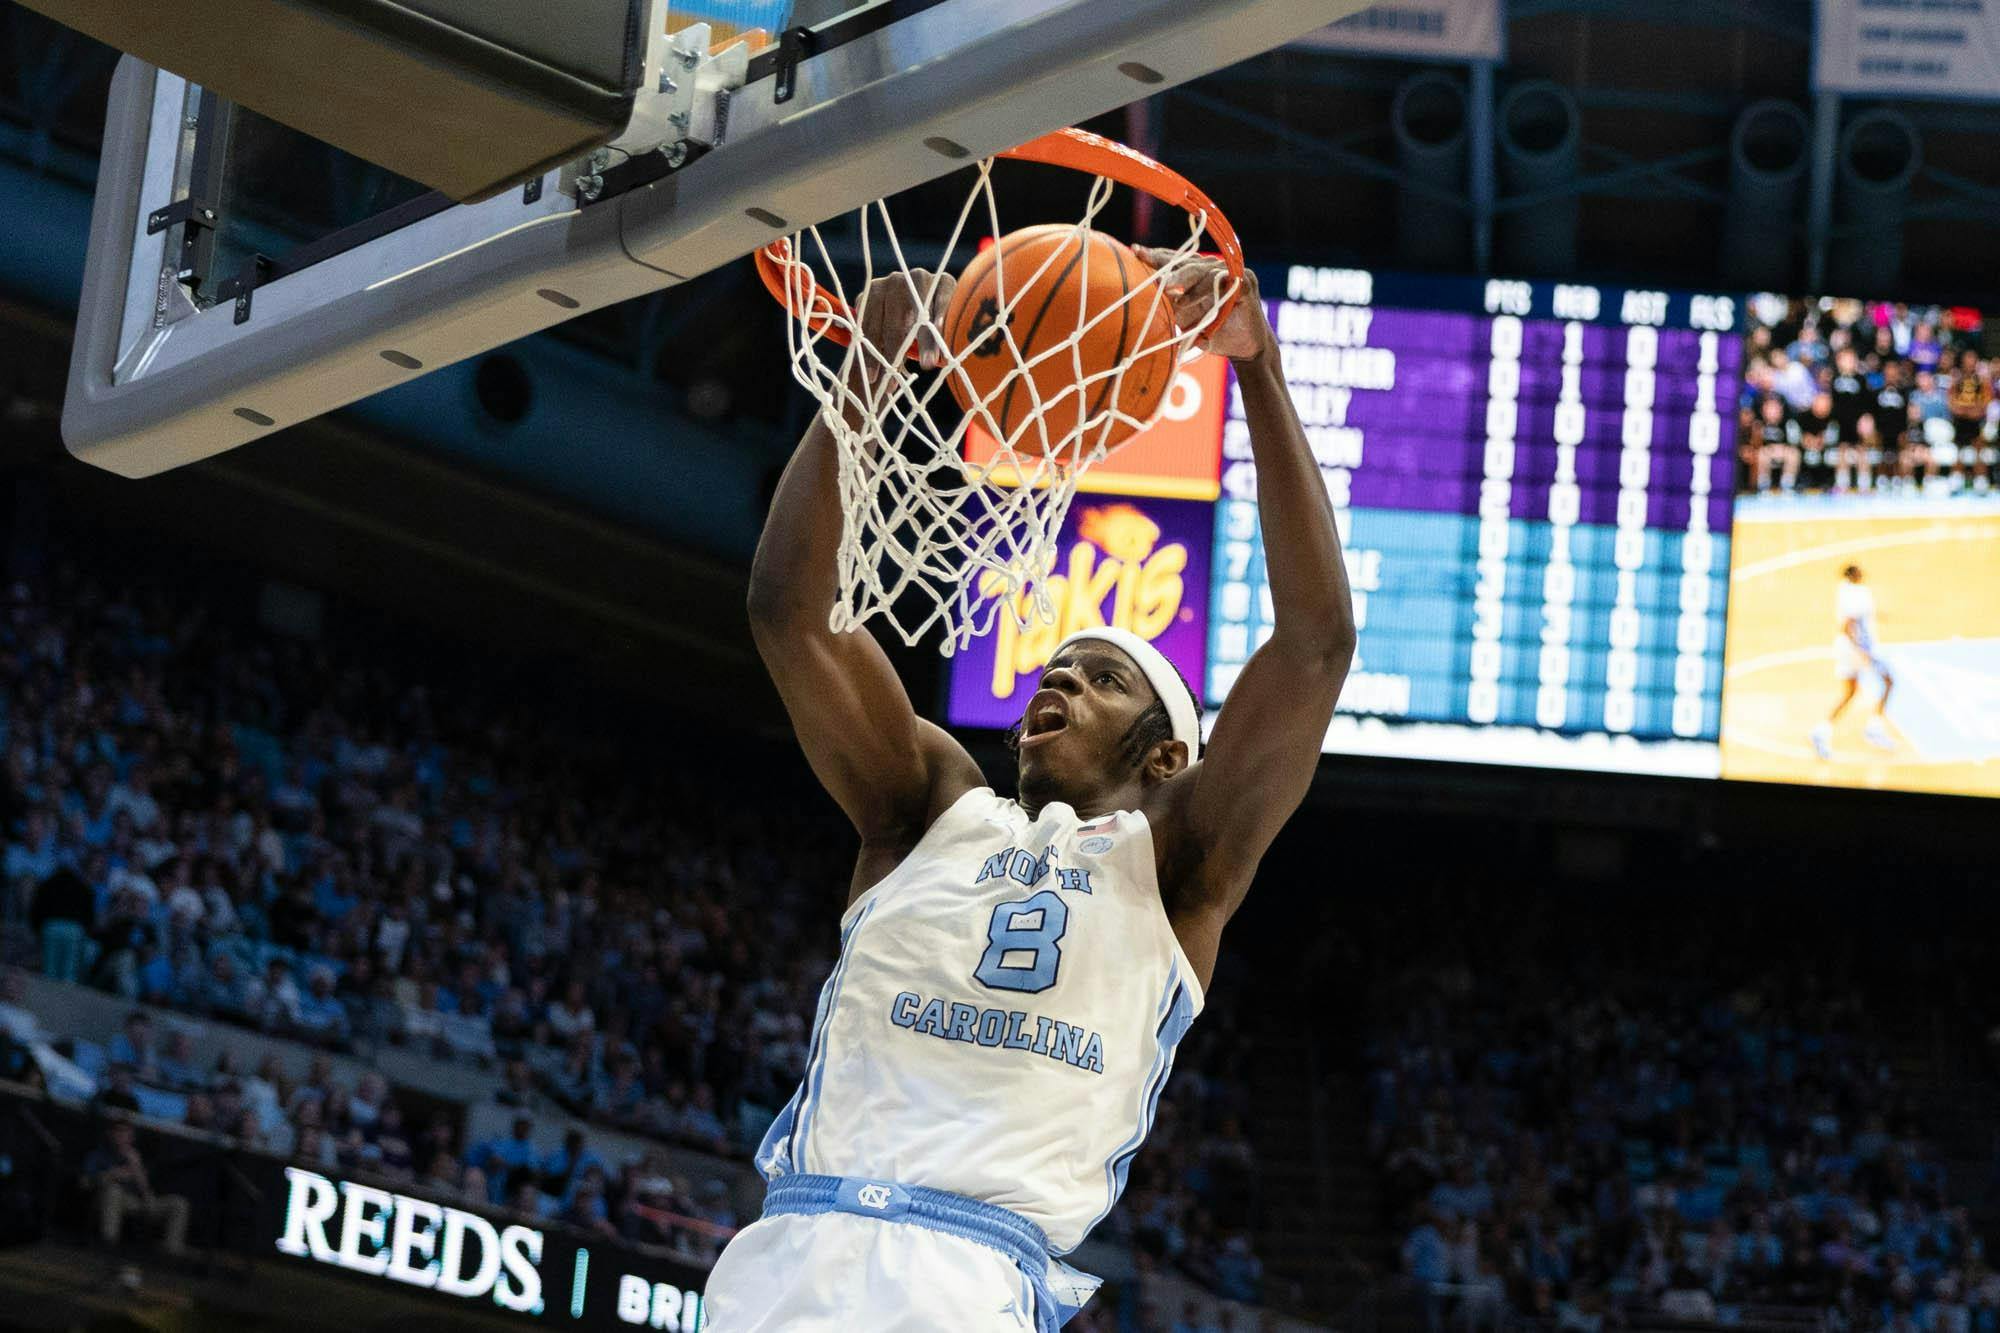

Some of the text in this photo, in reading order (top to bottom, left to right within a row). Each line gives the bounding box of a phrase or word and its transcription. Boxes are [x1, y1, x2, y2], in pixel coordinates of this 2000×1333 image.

[975, 844, 1093, 895] NORH
[973, 890, 1068, 994] 8
[891, 991, 1104, 1074] CAROLINA
[617, 1274, 707, 1333] BRI
